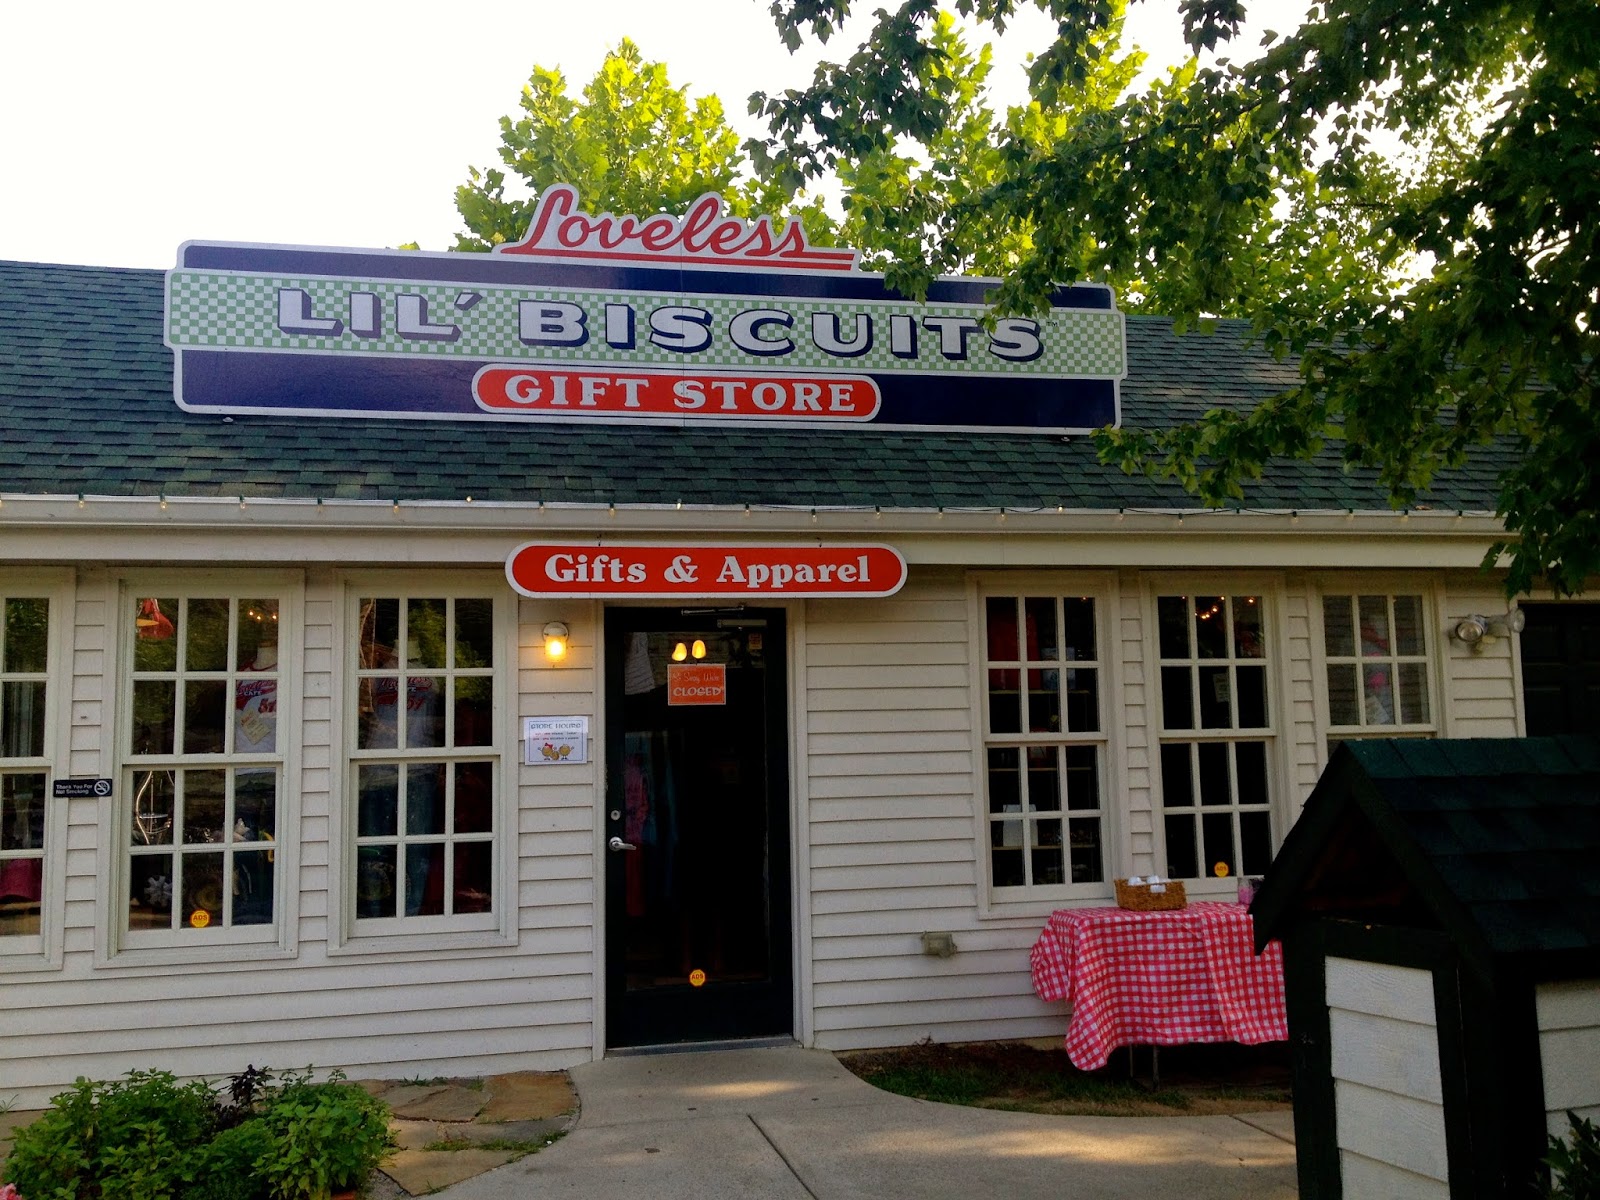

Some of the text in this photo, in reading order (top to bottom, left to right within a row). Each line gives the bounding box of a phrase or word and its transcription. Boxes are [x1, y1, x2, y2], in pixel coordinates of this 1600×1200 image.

[503, 187, 806, 258] Loveless
[277, 288, 483, 342] LIL'
[518, 299, 1045, 362] BISCUITS
[504, 374, 856, 412] GIFT STORE
[544, 553, 871, 589] Gifts & Apparel
[673, 686, 721, 697] CLOSED
